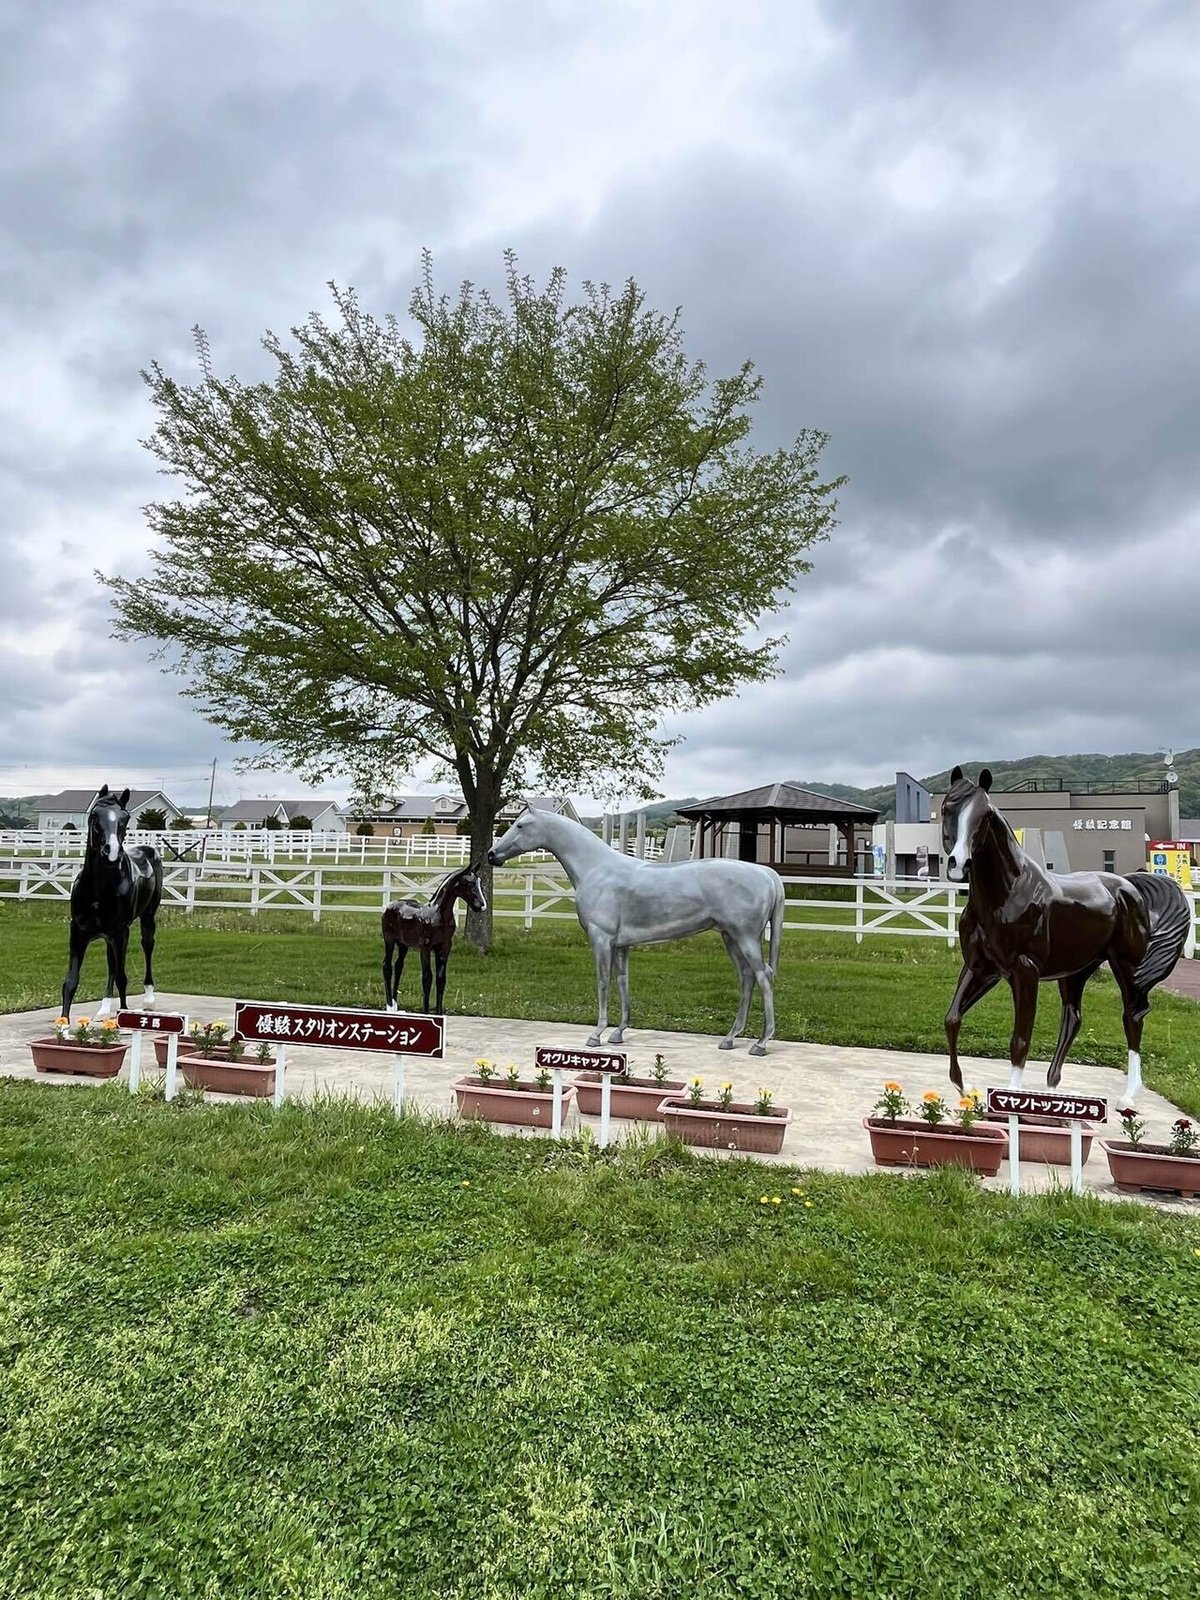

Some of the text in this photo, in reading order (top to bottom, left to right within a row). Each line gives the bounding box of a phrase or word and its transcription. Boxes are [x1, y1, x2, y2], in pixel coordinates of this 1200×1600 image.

[139, 1016, 161, 1028] 子馬
[256, 1014, 422, 1046] 優駿スタリオンステーション
[542, 1053, 620, 1070] オグリキャップ号
[996, 1095, 1100, 1117] マヤノトップガン号
